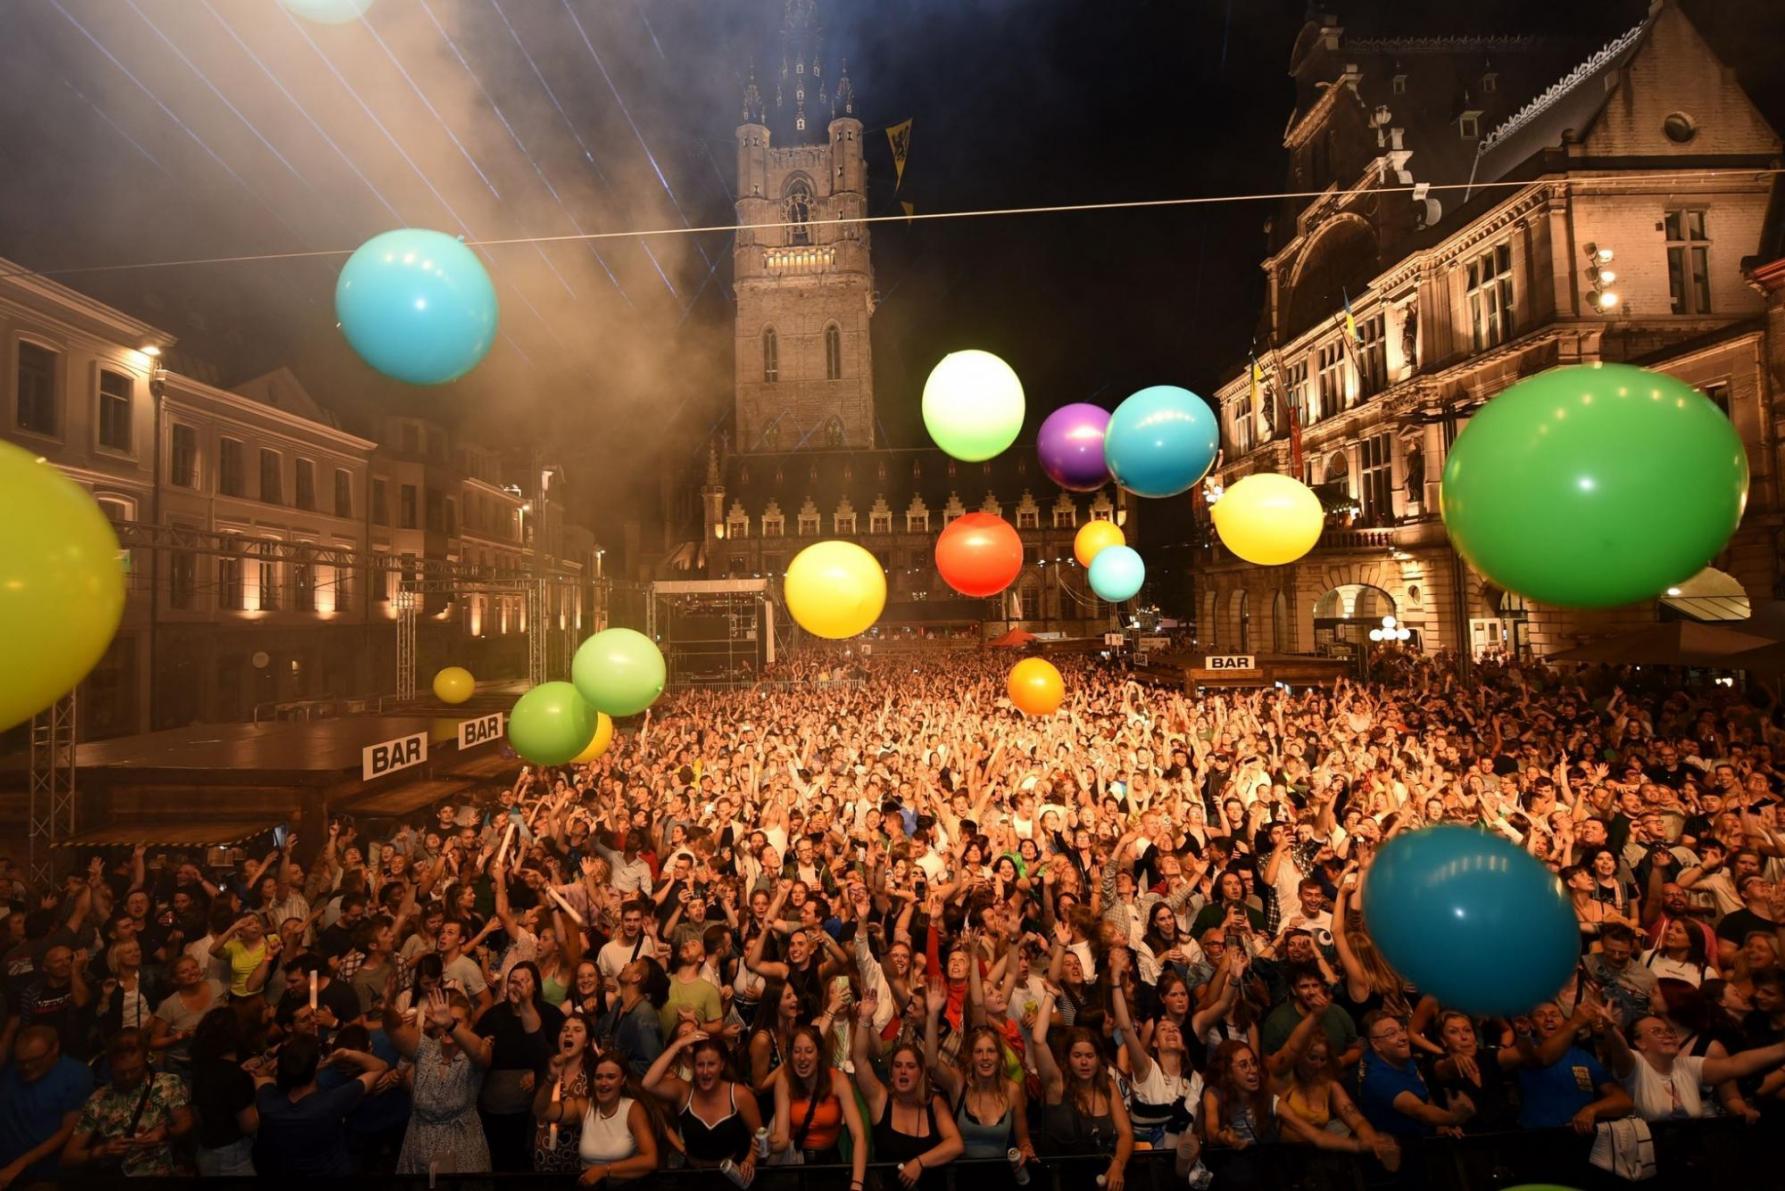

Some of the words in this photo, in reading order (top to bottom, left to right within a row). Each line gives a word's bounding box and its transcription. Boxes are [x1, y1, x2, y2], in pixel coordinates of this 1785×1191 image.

[1212, 658, 1248, 668] BAR
[465, 718, 497, 744] BAR
[373, 738, 420, 774] BAR
